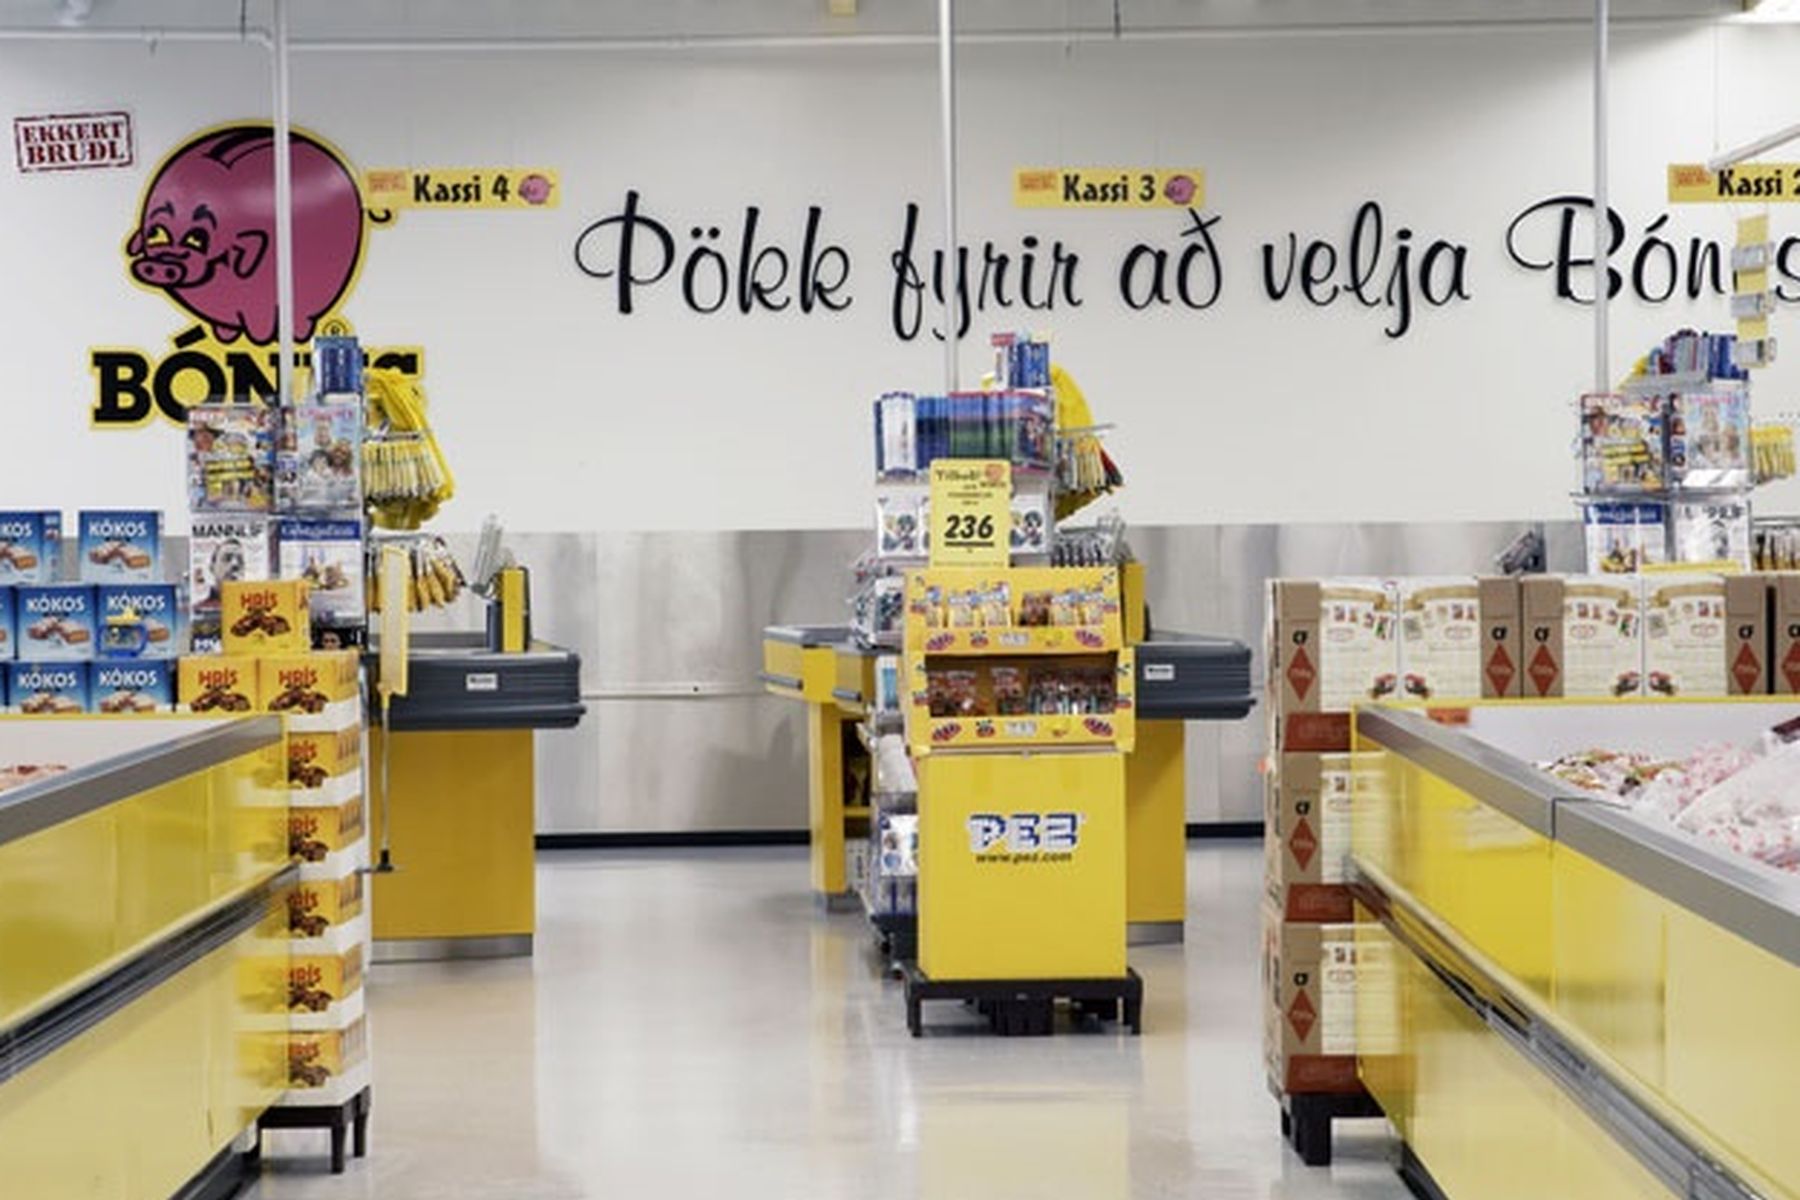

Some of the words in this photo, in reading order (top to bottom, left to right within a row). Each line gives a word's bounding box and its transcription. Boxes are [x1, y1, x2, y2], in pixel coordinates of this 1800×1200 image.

[23, 122, 124, 143] EKKERT
[414, 174, 481, 203] Kassi
[492, 174, 511, 203] 4
[1063, 174, 1129, 202] Kassi
[1139, 174, 1156, 202] 3
[1717, 168, 1783, 196] Kassi
[575, 190, 852, 314] Þökk
[892, 203, 1083, 341] fyrir
[1120, 207, 1222, 310] að
[1262, 201, 1471, 338] velja
[1506, 195, 1800, 304] Bóns
[93, 325, 418, 423] BÓN
[88, 519, 147, 537] KÓKOS
[944, 514, 994, 539] 236
[26, 593, 85, 612] KÓKOS
[107, 591, 165, 611] KÓKOS
[100, 667, 157, 686] KÓKOS
[976, 852, 1073, 864] www.pez.com
